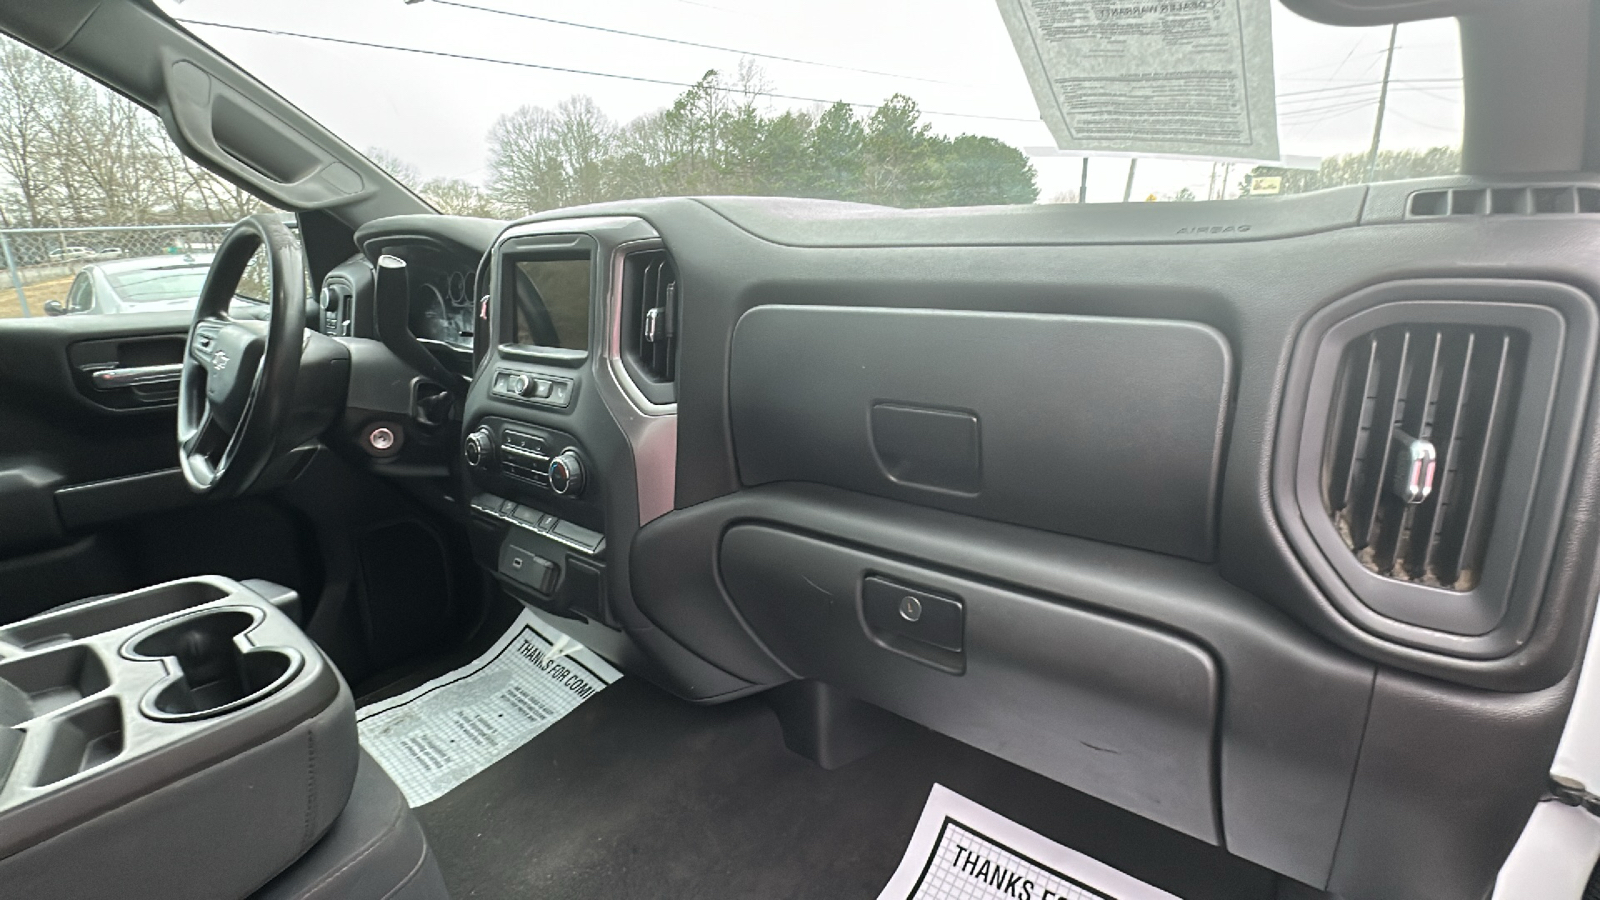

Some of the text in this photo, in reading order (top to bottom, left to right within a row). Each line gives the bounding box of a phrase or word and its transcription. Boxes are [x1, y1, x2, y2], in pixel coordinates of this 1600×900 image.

[1176, 224, 1252, 235] AIRBAG
[547, 664, 570, 682] FOR
[953, 844, 1034, 900] THANKS
